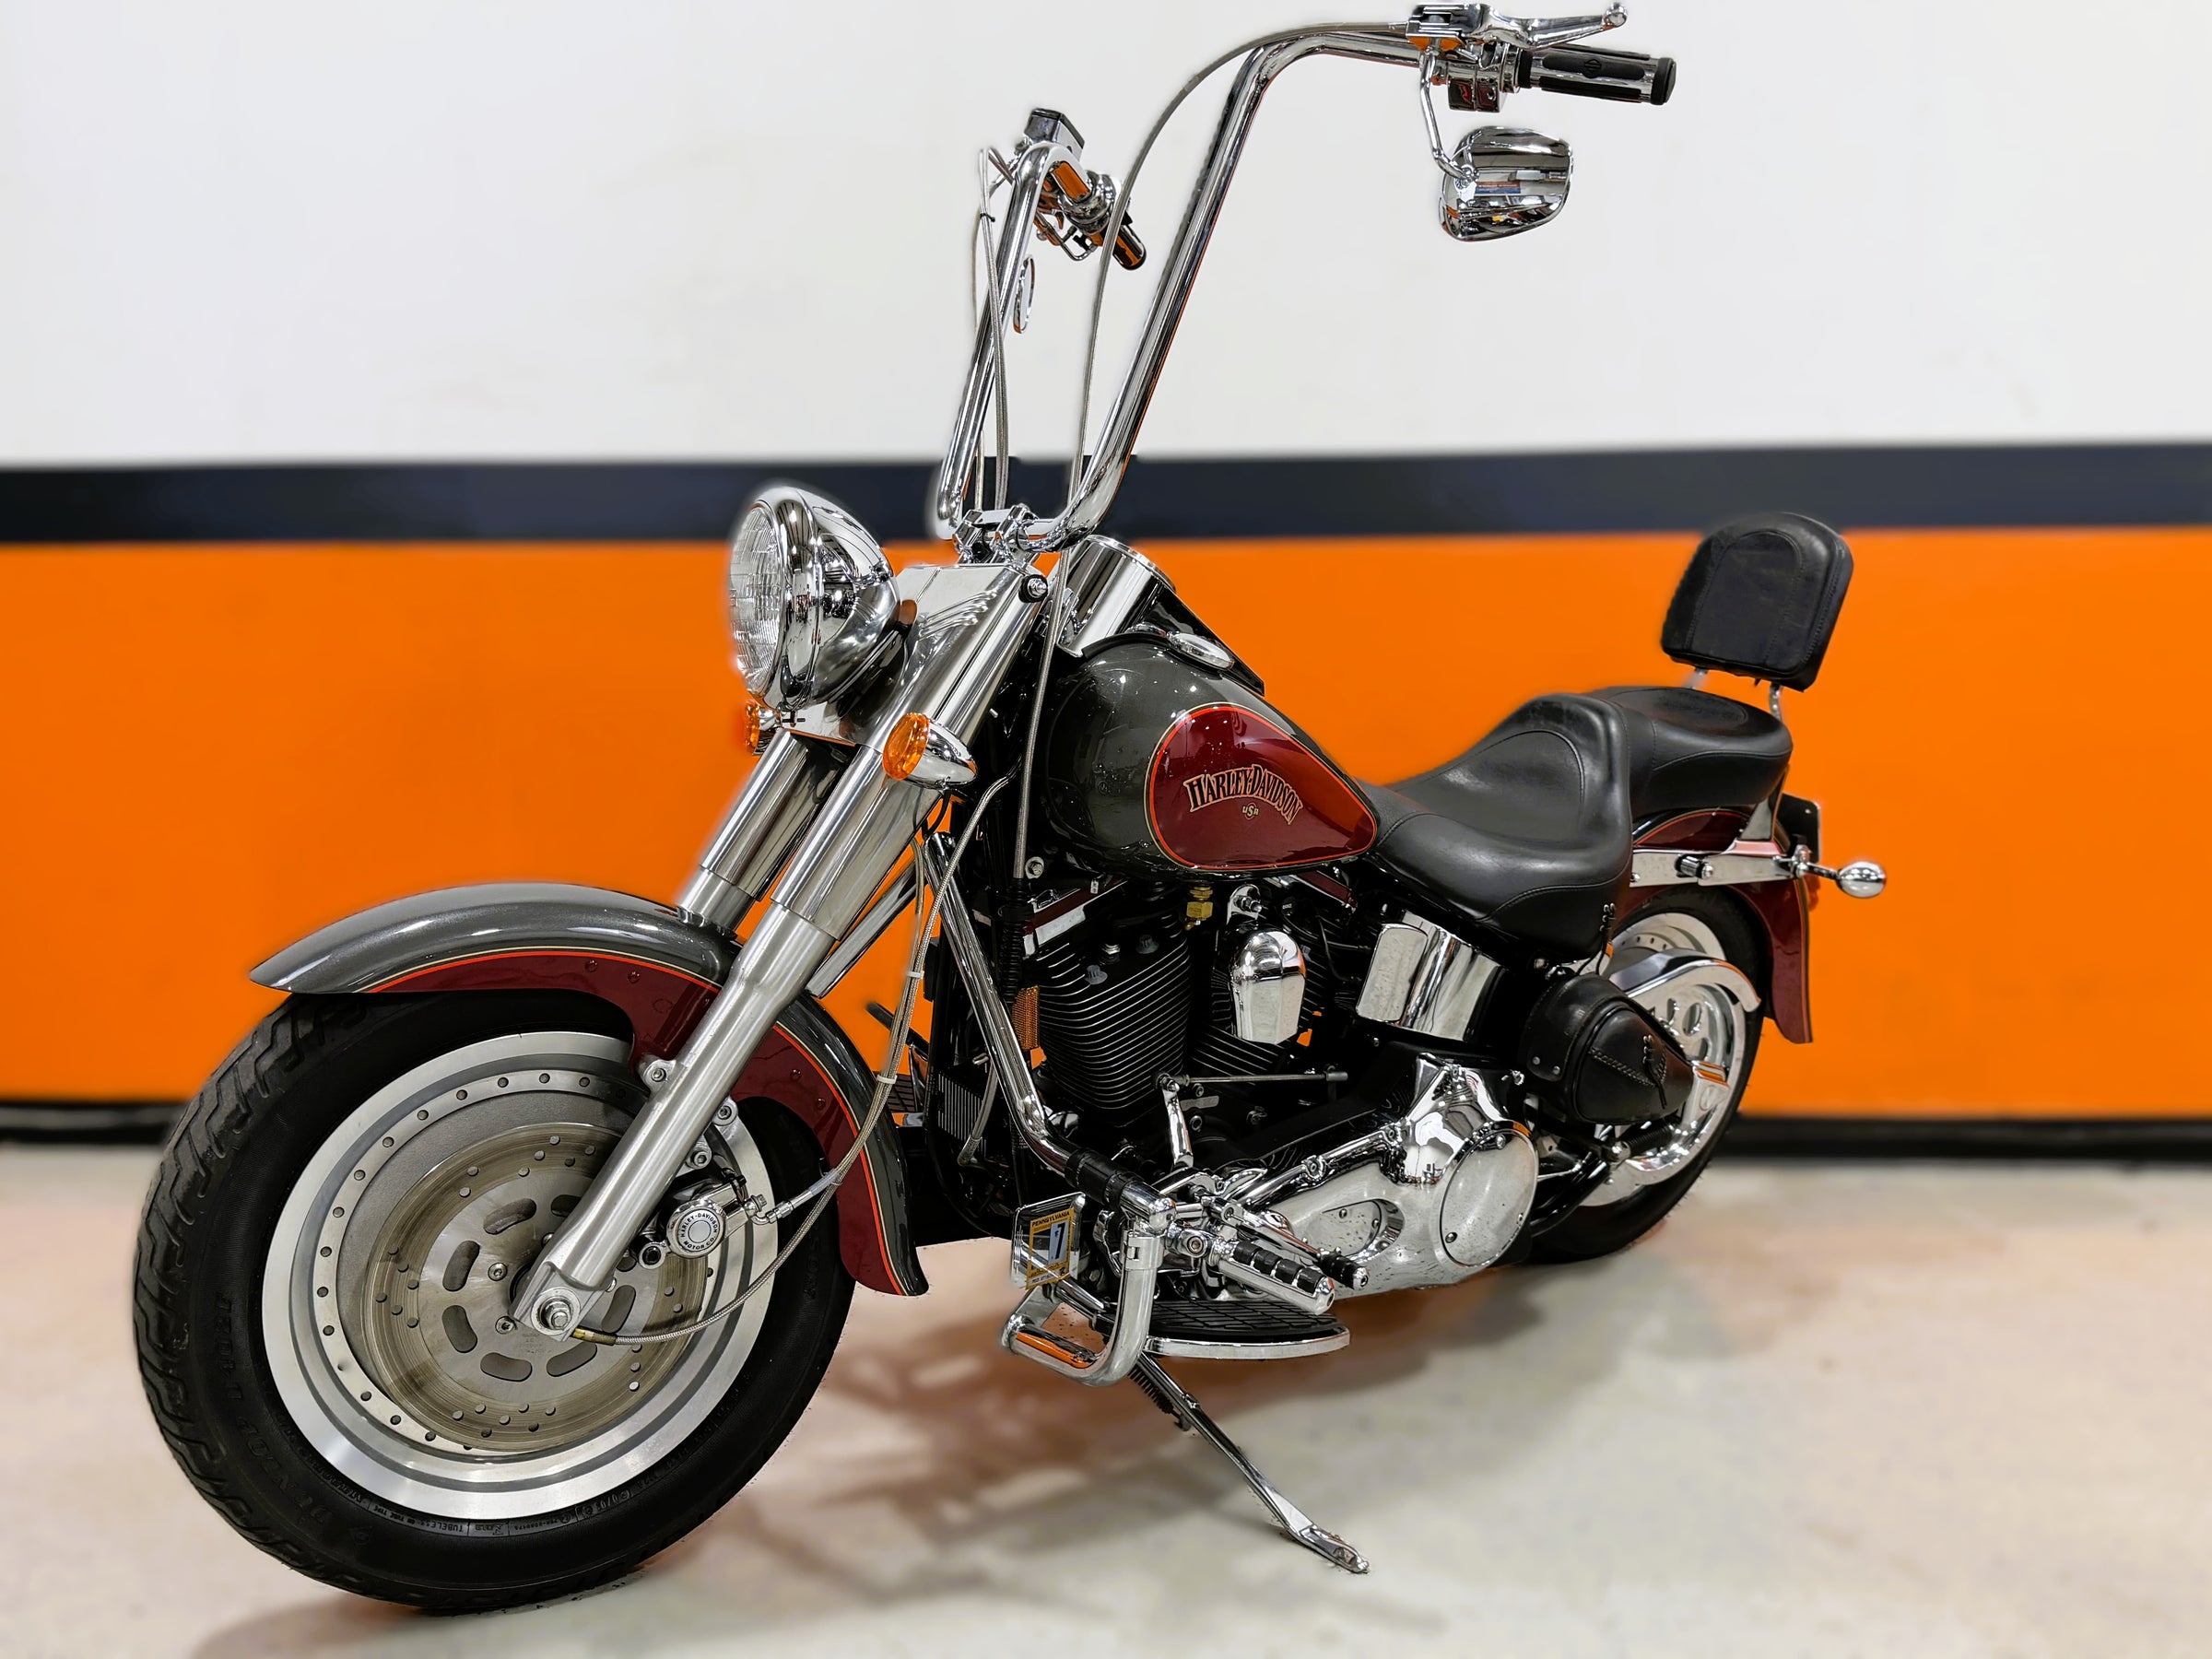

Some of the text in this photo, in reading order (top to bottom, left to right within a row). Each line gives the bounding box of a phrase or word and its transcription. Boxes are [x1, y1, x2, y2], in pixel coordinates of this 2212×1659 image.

[1183, 765, 1303, 824] HARLEY-DAVIDSON
[1242, 806, 1259, 817] USA
[681, 1214, 718, 1238] HARLEY-DAVIDSON
[1031, 1211, 1070, 1228] PENNSYLVANIA
[683, 1241, 705, 1250] MOTOR
